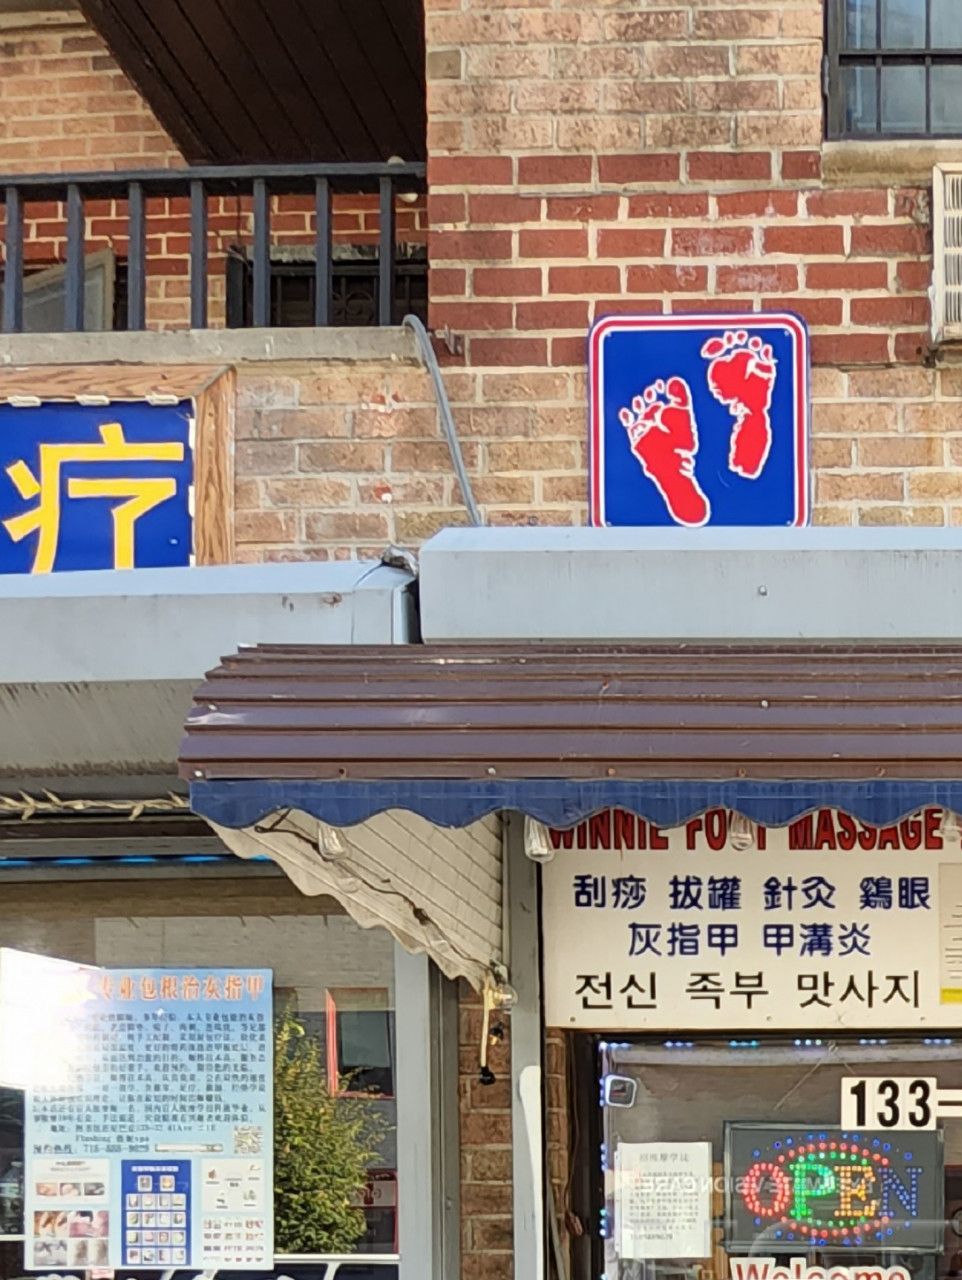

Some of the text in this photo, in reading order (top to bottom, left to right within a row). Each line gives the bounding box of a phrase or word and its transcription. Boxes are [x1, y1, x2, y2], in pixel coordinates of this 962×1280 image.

[2, 422, 185, 574] 疗
[789, 808, 943, 851] MASSAGE
[668, 874, 742, 911] 拔罐
[763, 875, 836, 911] 針灸
[628, 922, 872, 957] 灰指甲 甲溝炎
[574, 970, 920, 1010] 전신 족부 맛사지
[742, 1162, 924, 1220] OPEN
